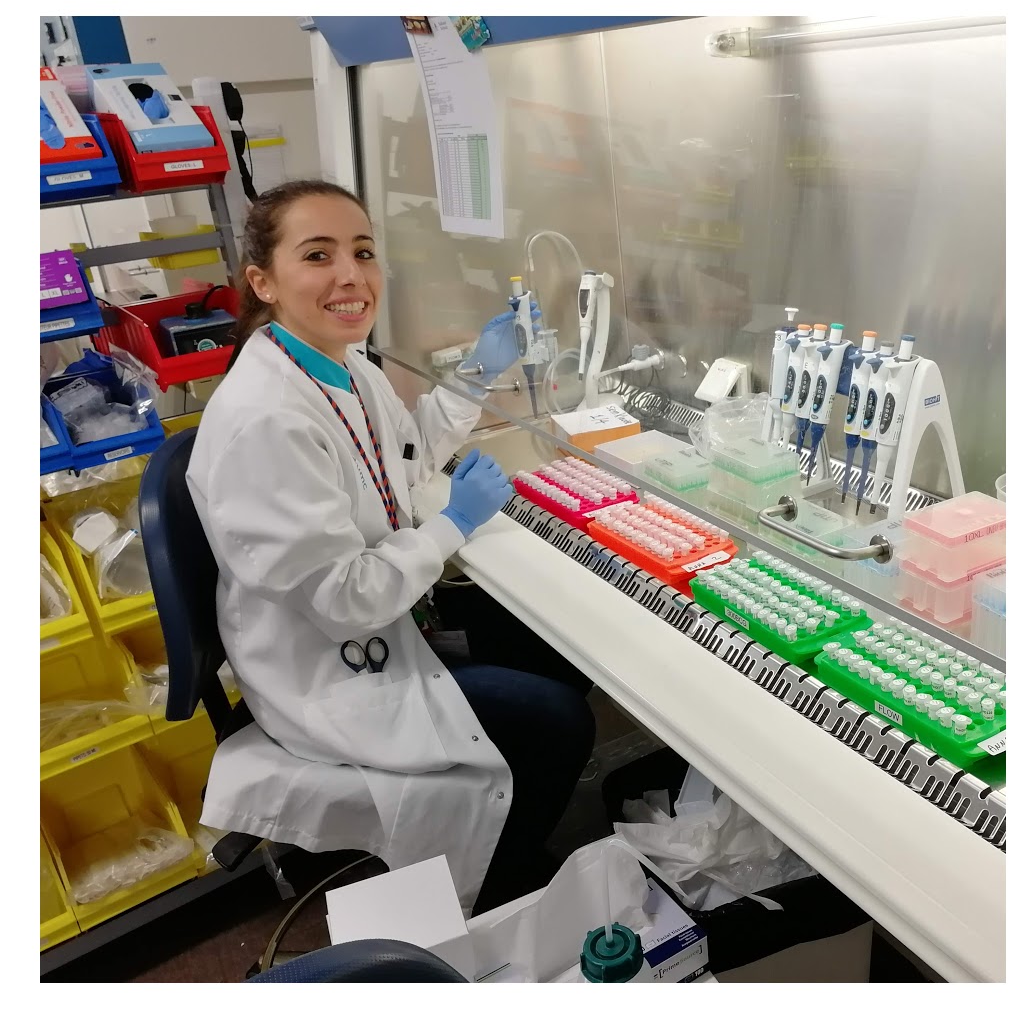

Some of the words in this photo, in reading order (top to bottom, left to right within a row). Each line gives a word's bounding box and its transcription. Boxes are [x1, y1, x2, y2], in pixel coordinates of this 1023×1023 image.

[878, 704, 900, 722] FLOW
[656, 932, 671, 943] Facial
[671, 924, 689, 935] tissues
